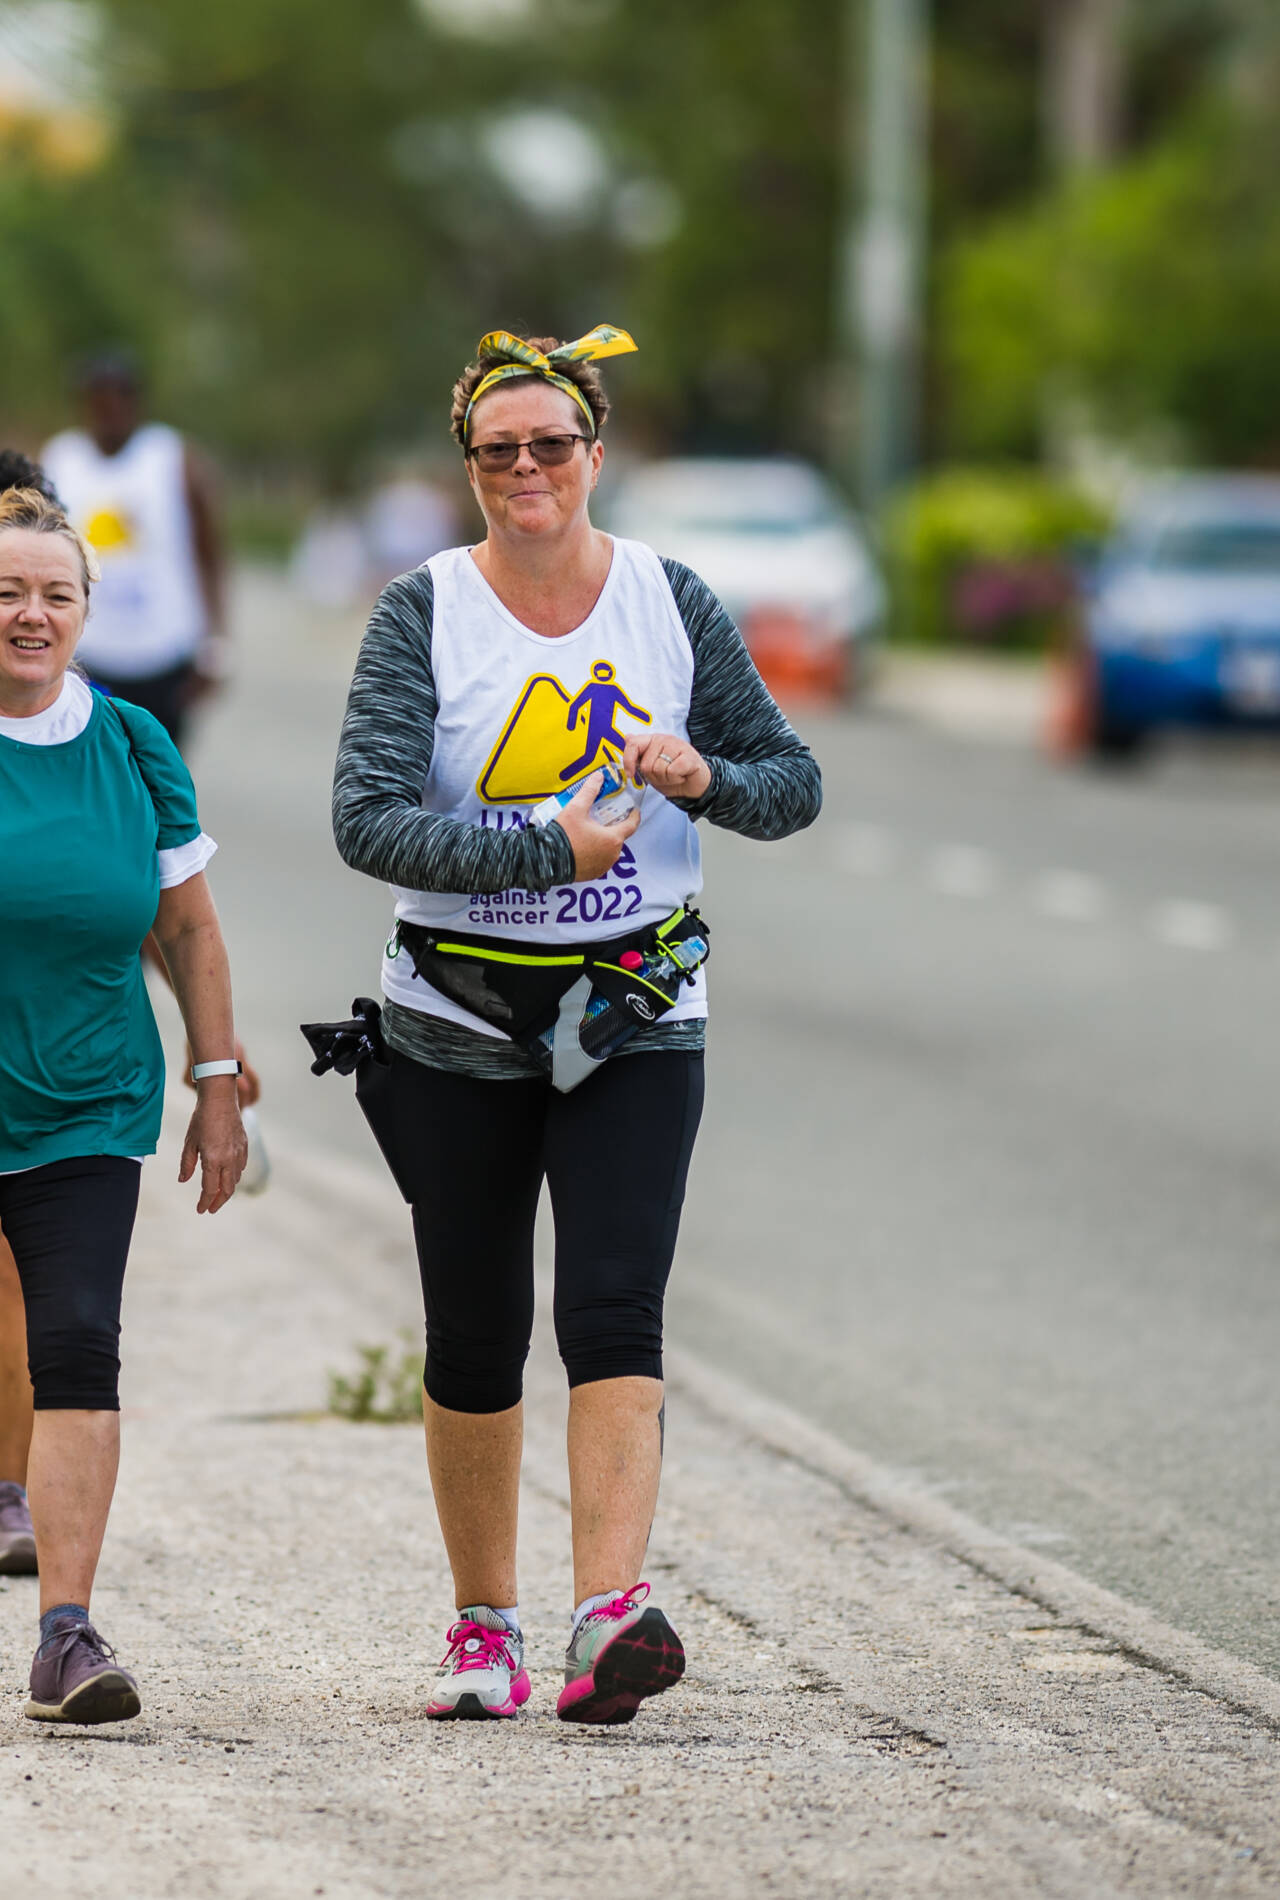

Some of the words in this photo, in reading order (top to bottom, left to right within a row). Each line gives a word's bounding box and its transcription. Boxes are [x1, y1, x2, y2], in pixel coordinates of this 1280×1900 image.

[469, 886, 548, 908] against
[555, 884, 643, 924] 2022
[468, 908, 550, 925] cancer
